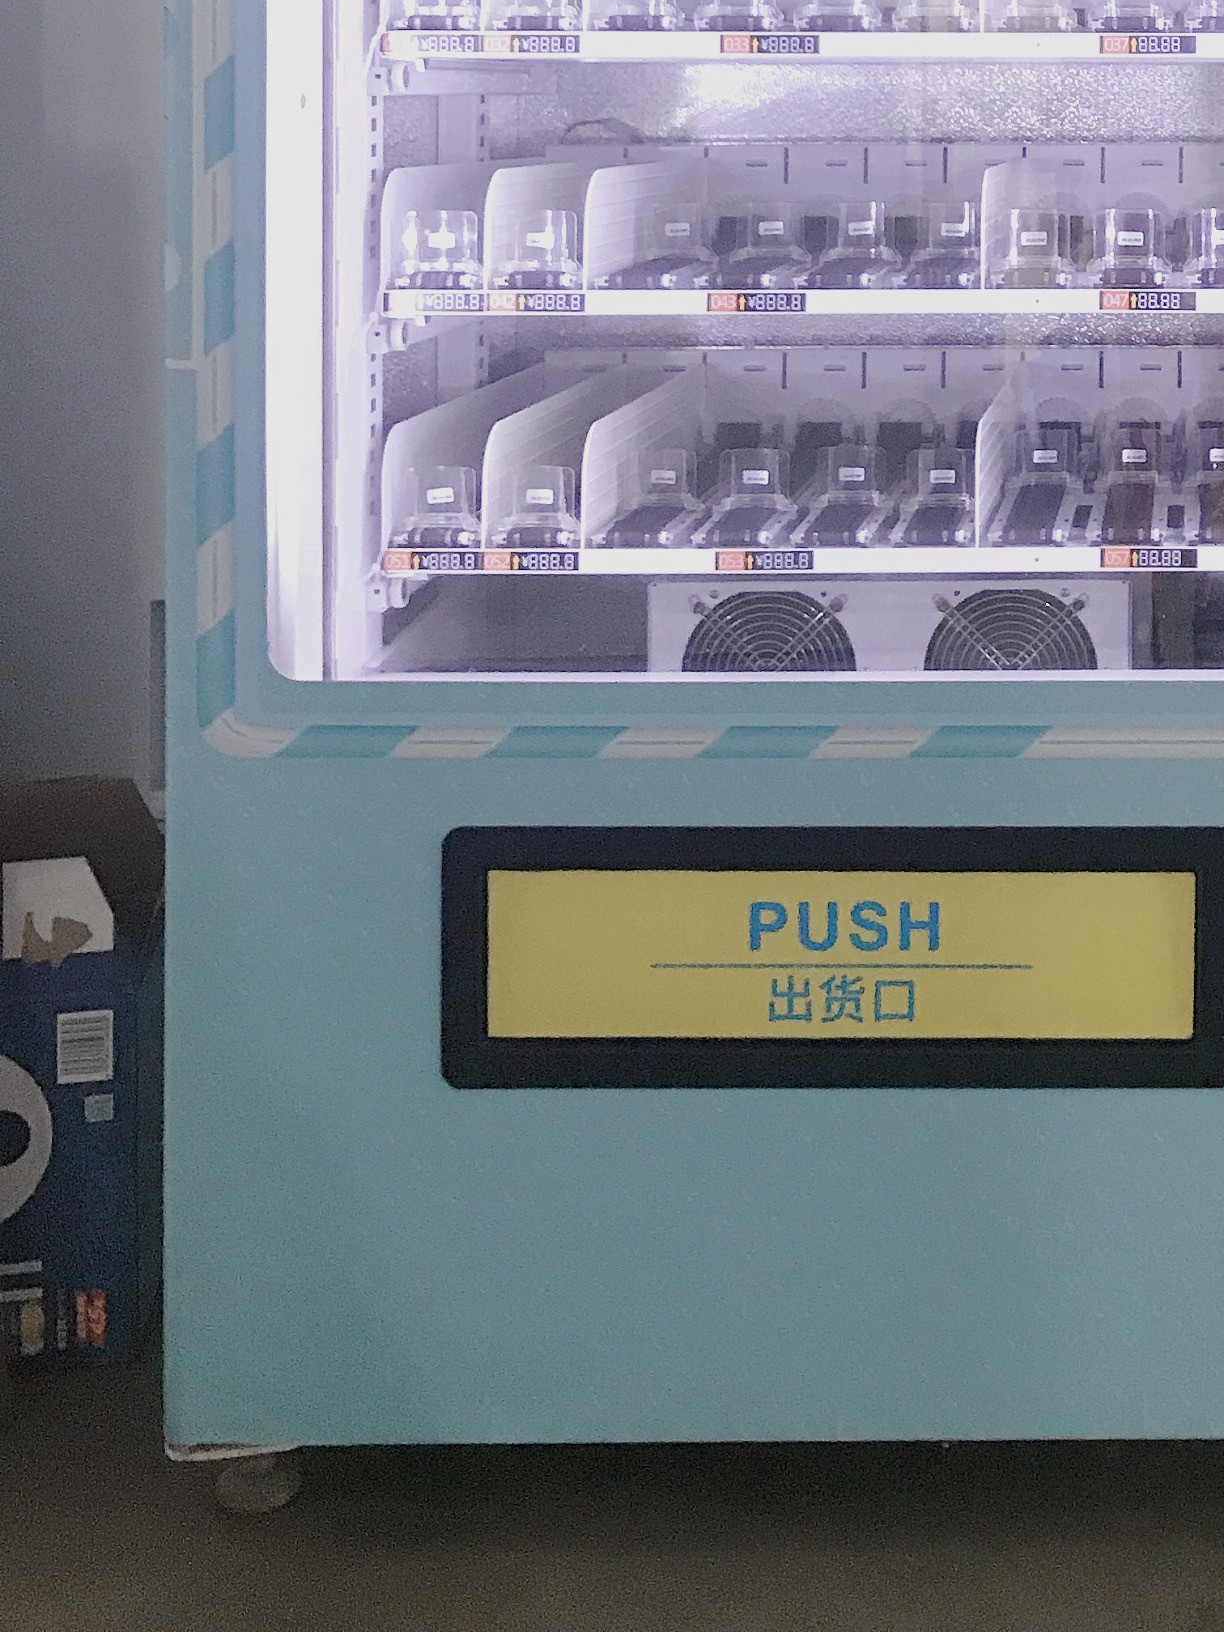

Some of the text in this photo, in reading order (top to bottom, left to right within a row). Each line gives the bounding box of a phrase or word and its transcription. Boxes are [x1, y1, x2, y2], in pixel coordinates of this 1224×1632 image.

[723, 36, 749, 52] 033
[1103, 36, 1128, 52] 037
[710, 294, 736, 310] 043
[1103, 293, 1128, 309] 047
[748, 900, 943, 952] PUSH
[767, 976, 915, 1023] 出货口
